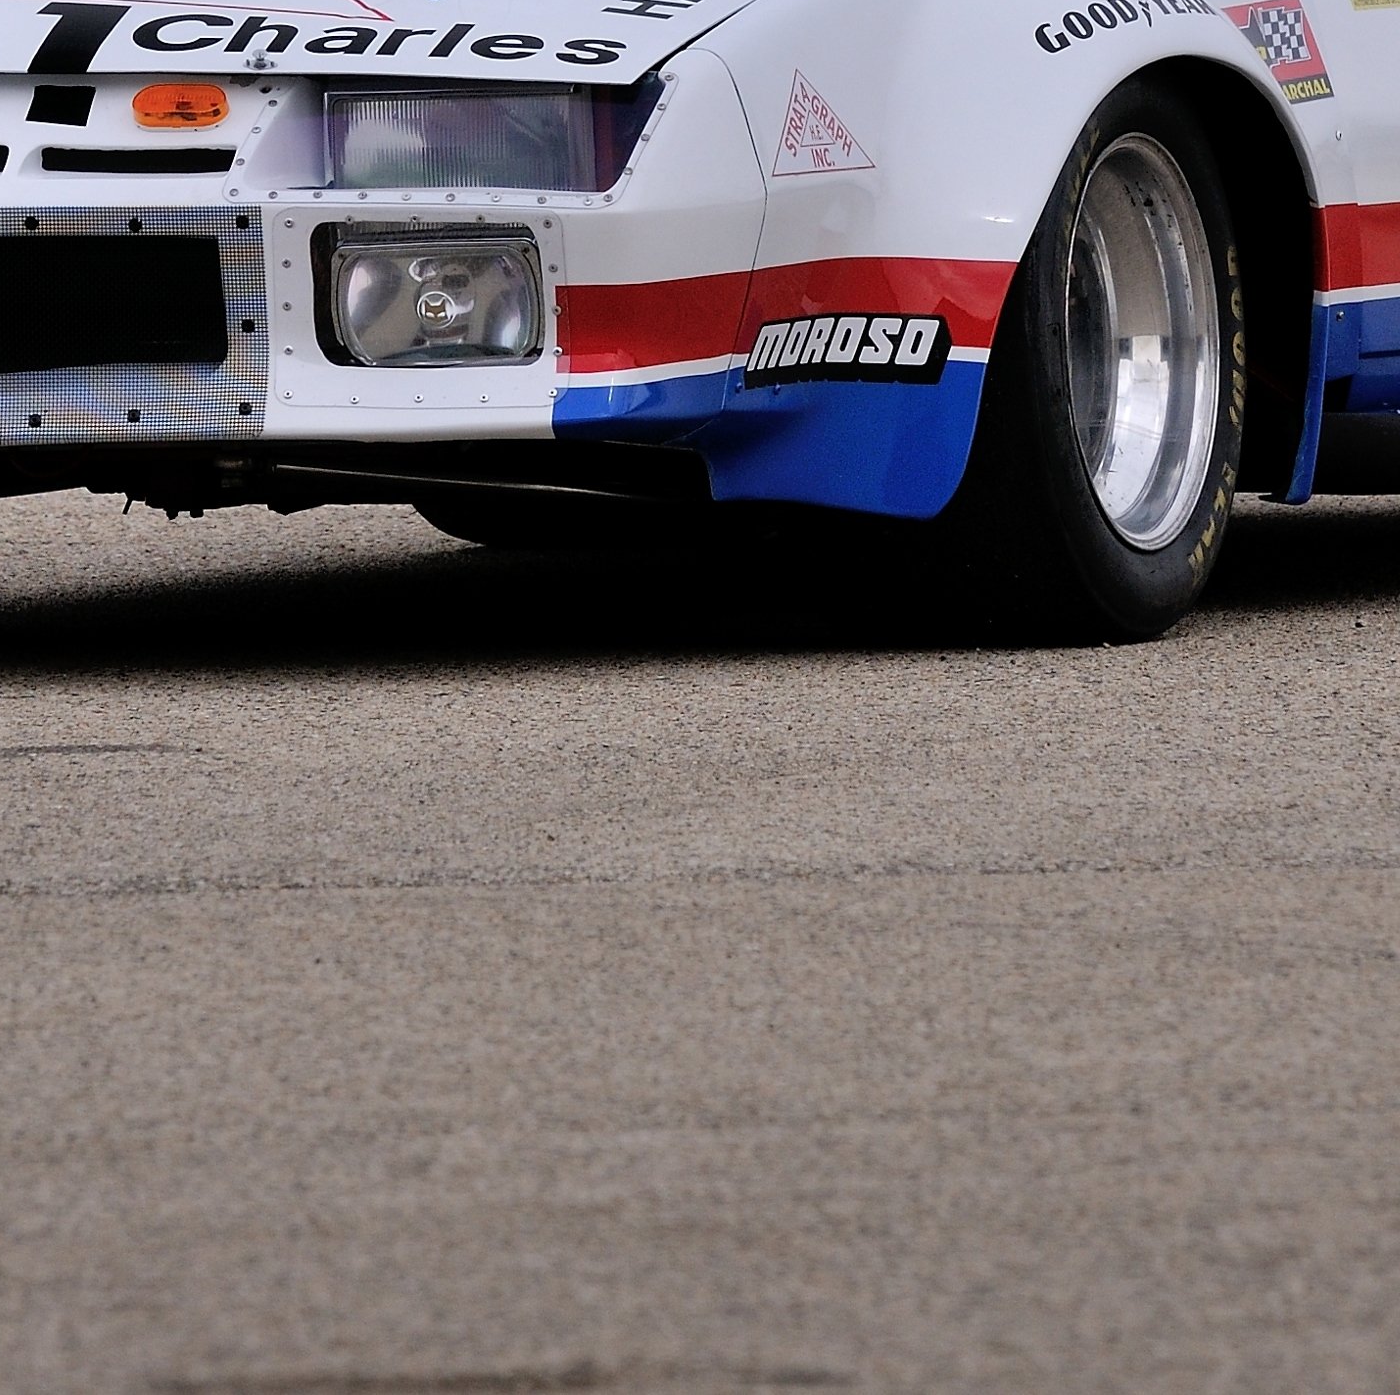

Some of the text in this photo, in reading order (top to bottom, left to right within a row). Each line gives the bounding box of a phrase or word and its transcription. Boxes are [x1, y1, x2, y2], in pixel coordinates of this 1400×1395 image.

[132, 13, 628, 65] Charles
[811, 148, 835, 168] INC.
[747, 316, 940, 371] MOROSO
